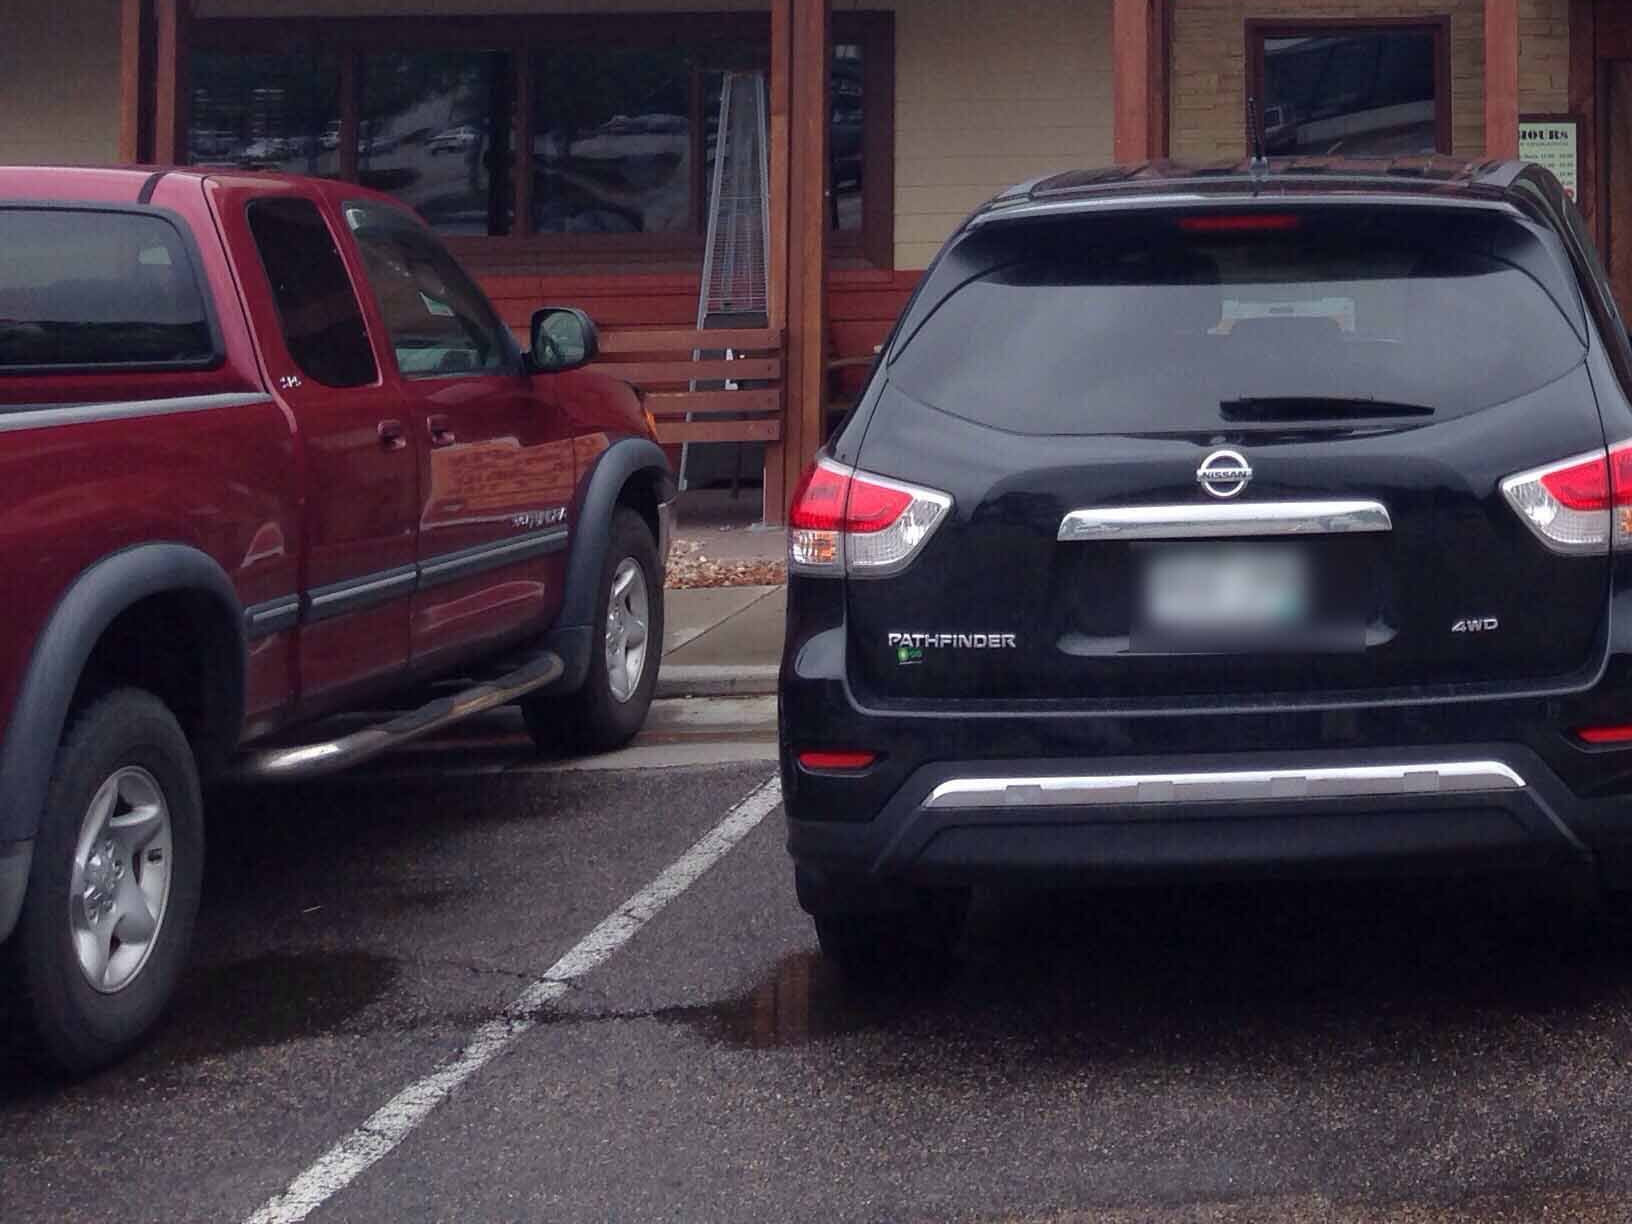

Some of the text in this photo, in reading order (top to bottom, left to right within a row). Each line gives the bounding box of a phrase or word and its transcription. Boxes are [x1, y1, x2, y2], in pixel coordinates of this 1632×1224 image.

[1202, 470, 1248, 479] NISSAN
[1451, 618, 1499, 633] 4WD
[888, 632, 1017, 649] PATHFINDER
